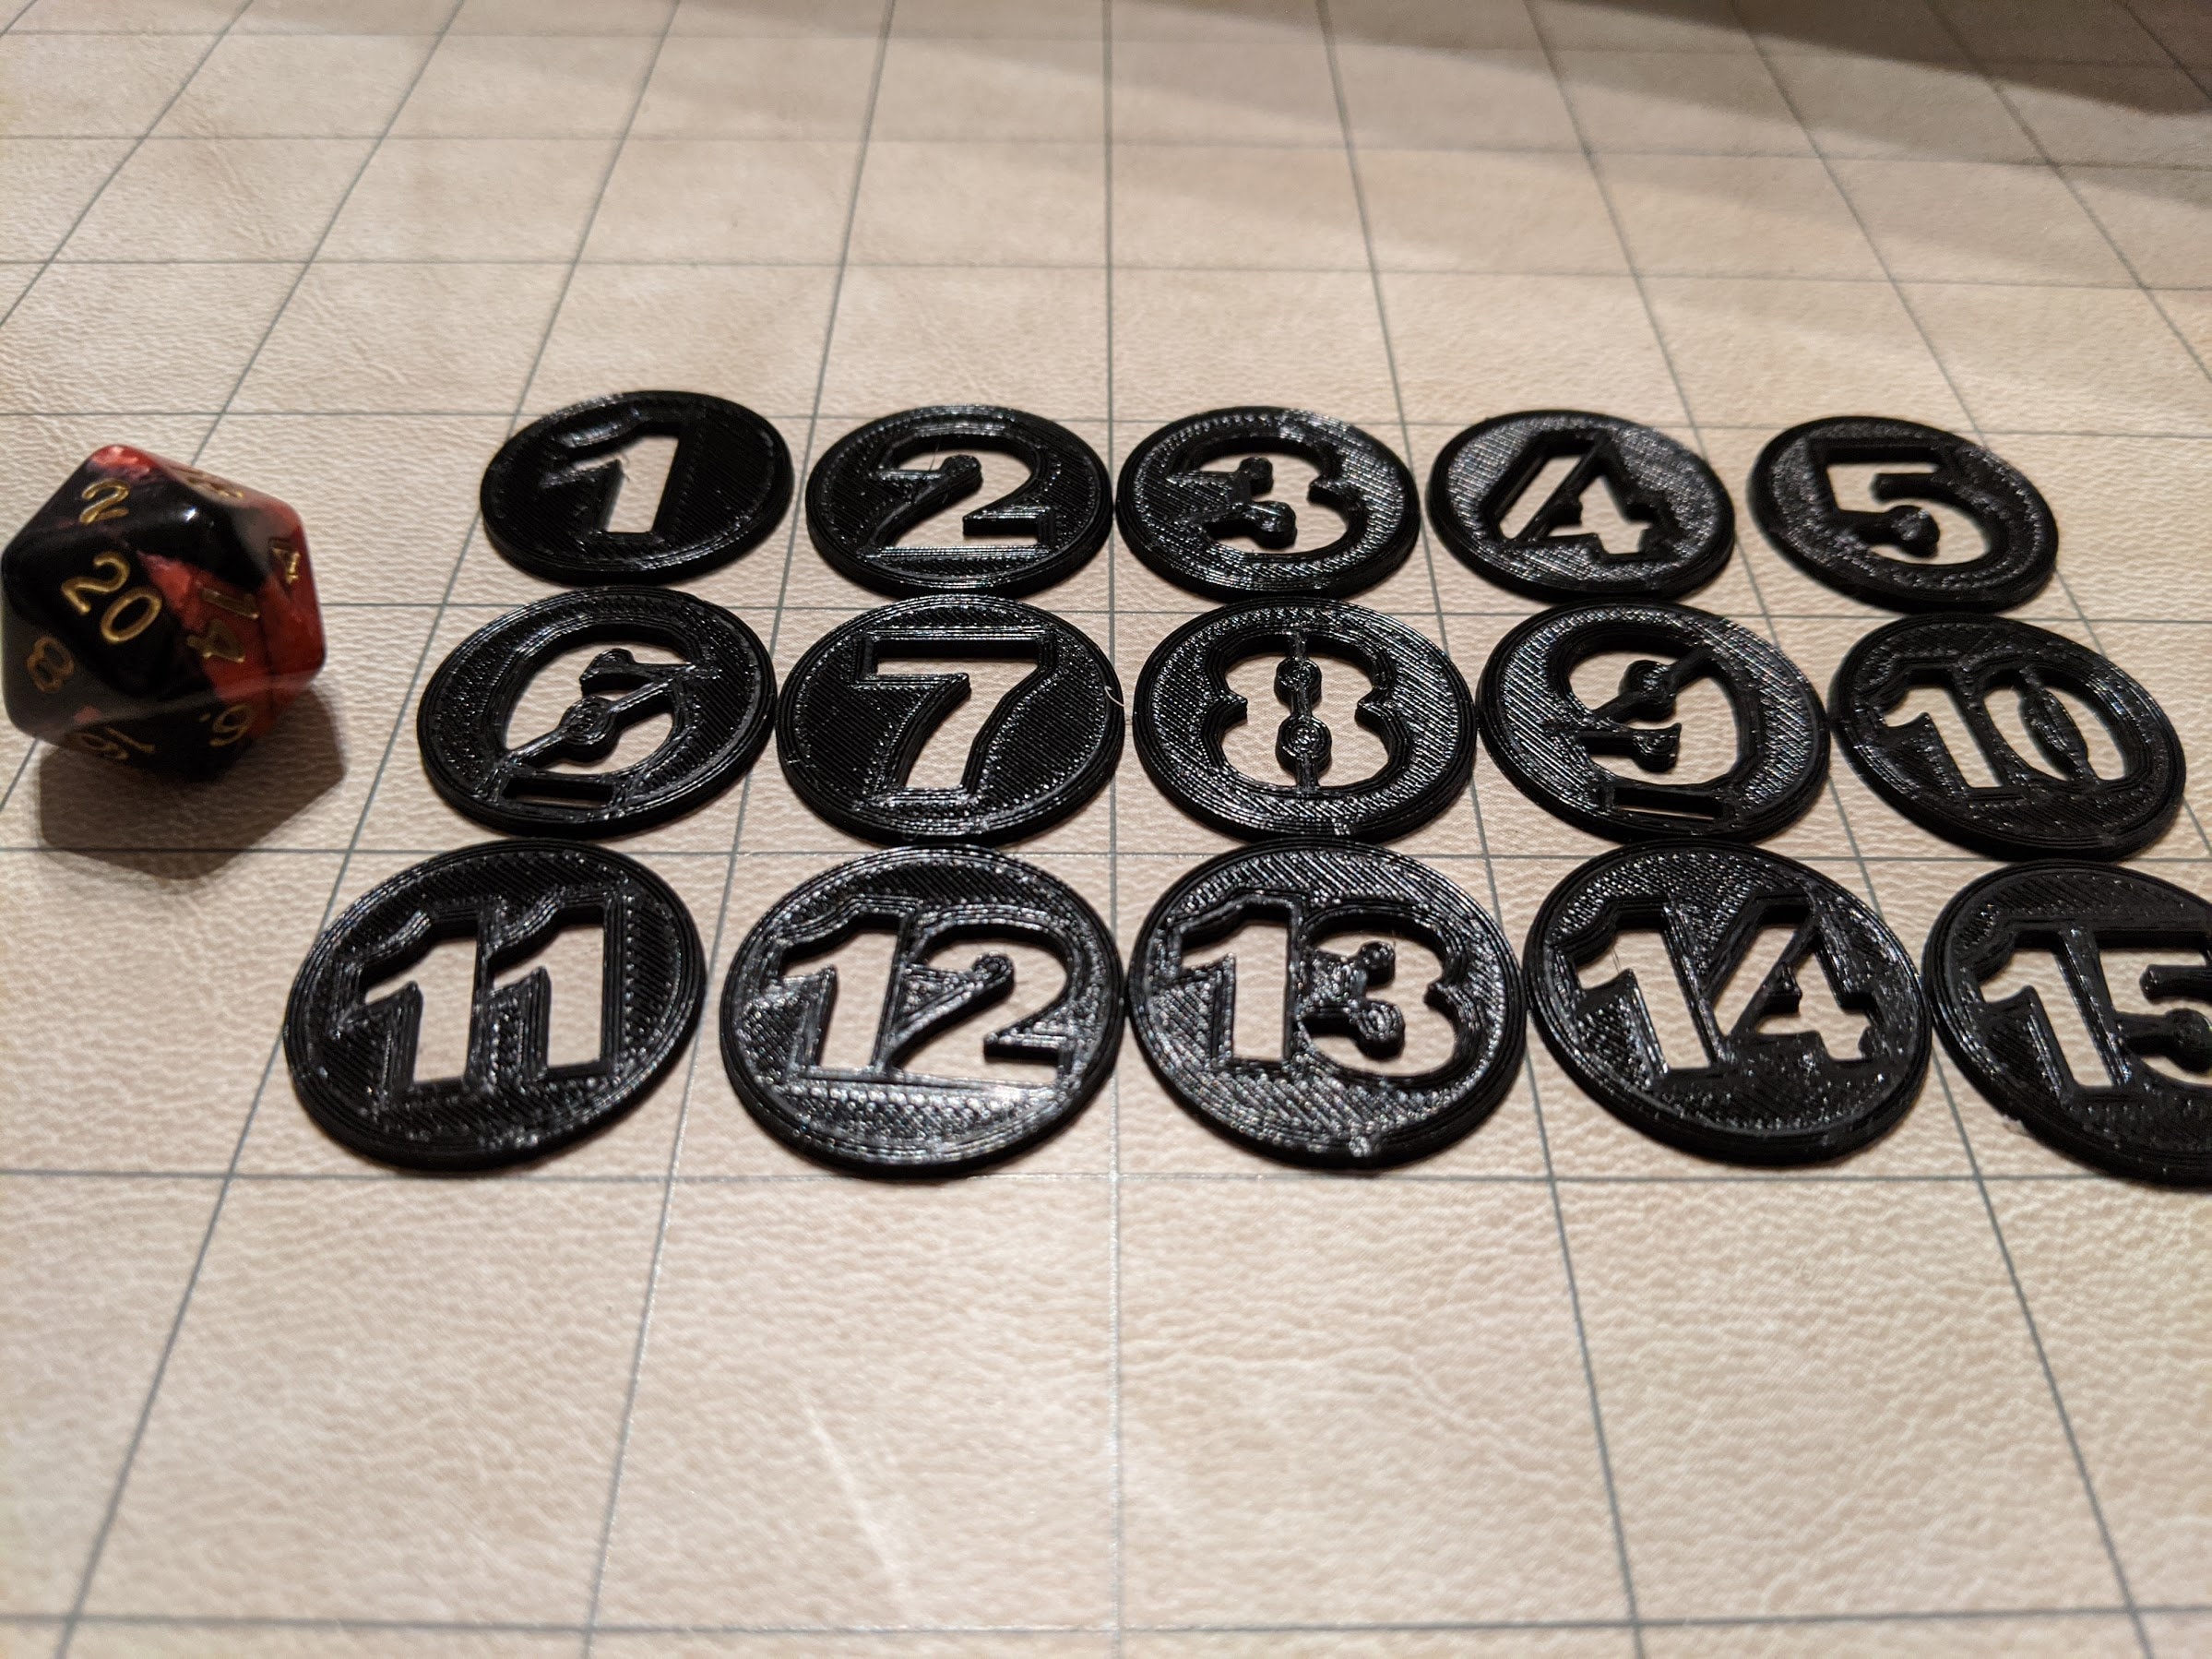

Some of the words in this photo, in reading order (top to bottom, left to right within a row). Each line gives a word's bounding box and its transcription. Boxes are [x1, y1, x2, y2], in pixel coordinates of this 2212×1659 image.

[78, 478, 130, 524] 2
[558, 426, 683, 534] 1
[870, 437, 1044, 548] 2
[1193, 436, 1354, 554] 3
[1493, 438, 1660, 555] 4
[1819, 450, 1992, 566] 5
[61, 551, 163, 644] 20
[26, 635, 75, 694] 8
[500, 637, 690, 779] 6
[865, 641, 1042, 790] 7
[1216, 639, 1400, 789] 8
[1563, 640, 1743, 787] 9
[1878, 666, 2128, 789] 10
[362, 912, 609, 1083] 11
[779, 921, 1070, 1086] 12
[1179, 915, 1462, 1075] 13
[1571, 909, 1878, 1073] 14
[1977, 934, 2212, 1090] 15
